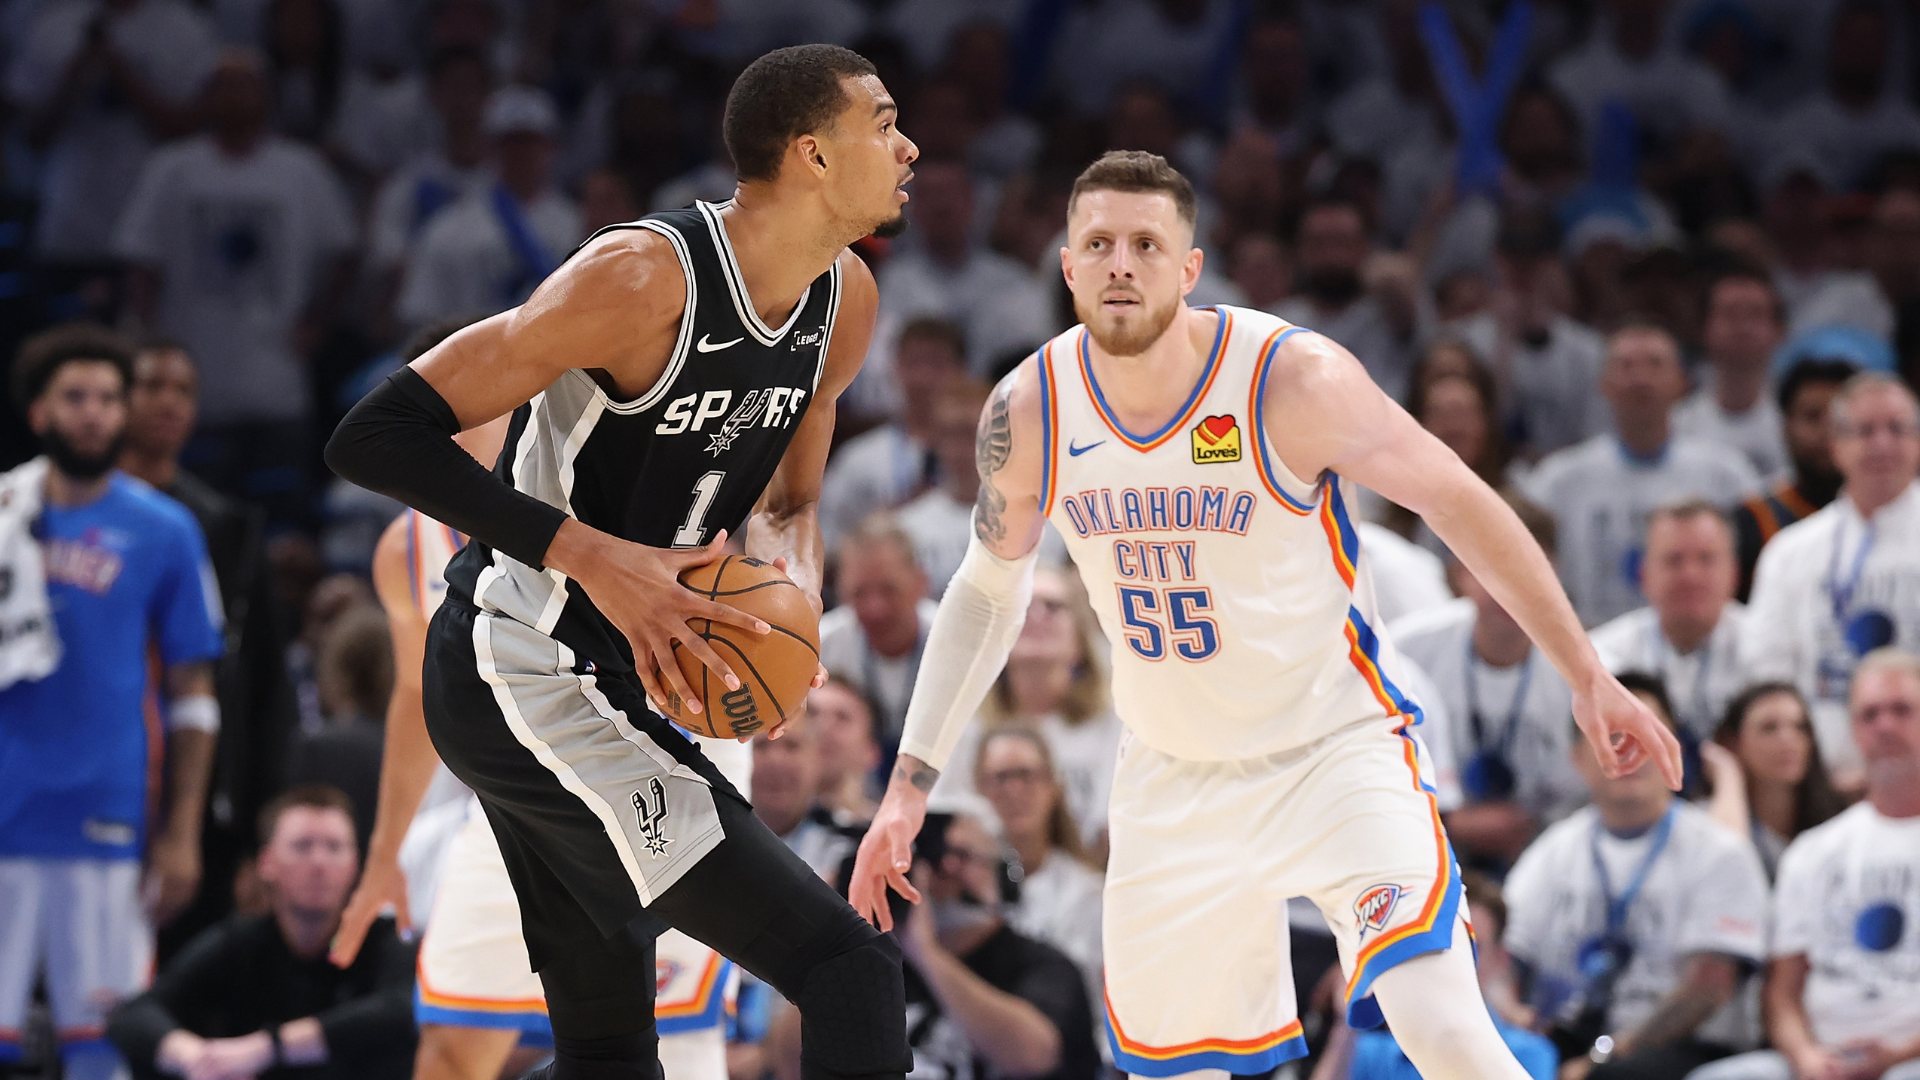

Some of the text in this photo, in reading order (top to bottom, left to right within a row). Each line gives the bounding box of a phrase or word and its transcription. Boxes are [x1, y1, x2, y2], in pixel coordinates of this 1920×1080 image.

[670, 470, 726, 548] 1
[1062, 485, 1257, 538] OKLAHOMA
[1113, 540, 1196, 582] CITY
[1115, 582, 1222, 663] 55
